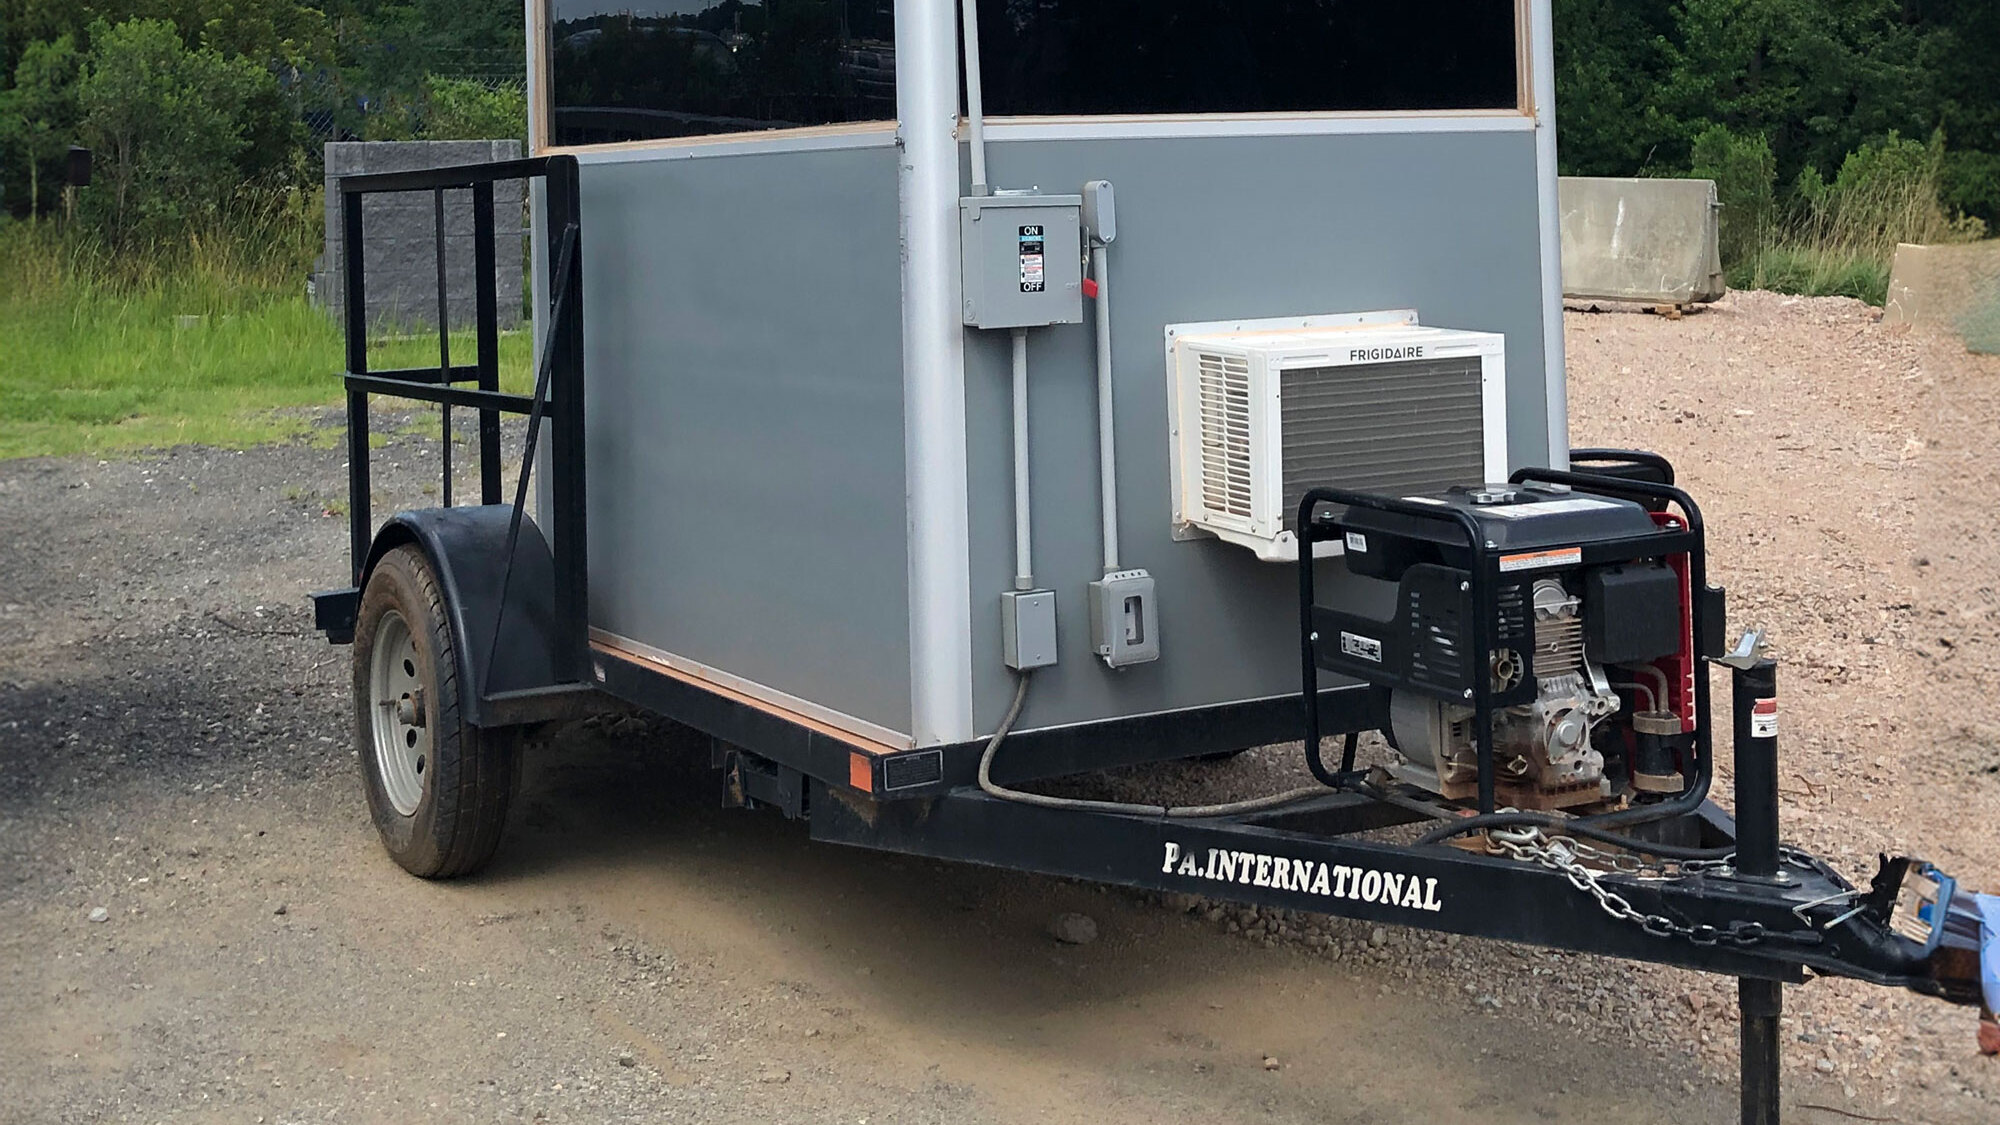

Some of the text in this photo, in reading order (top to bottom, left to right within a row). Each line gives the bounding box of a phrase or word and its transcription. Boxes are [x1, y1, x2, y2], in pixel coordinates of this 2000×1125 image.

[1024, 226, 1038, 235] ON
[1023, 282, 1042, 291] OFF
[1350, 346, 1423, 361] FRIGIDAIRE
